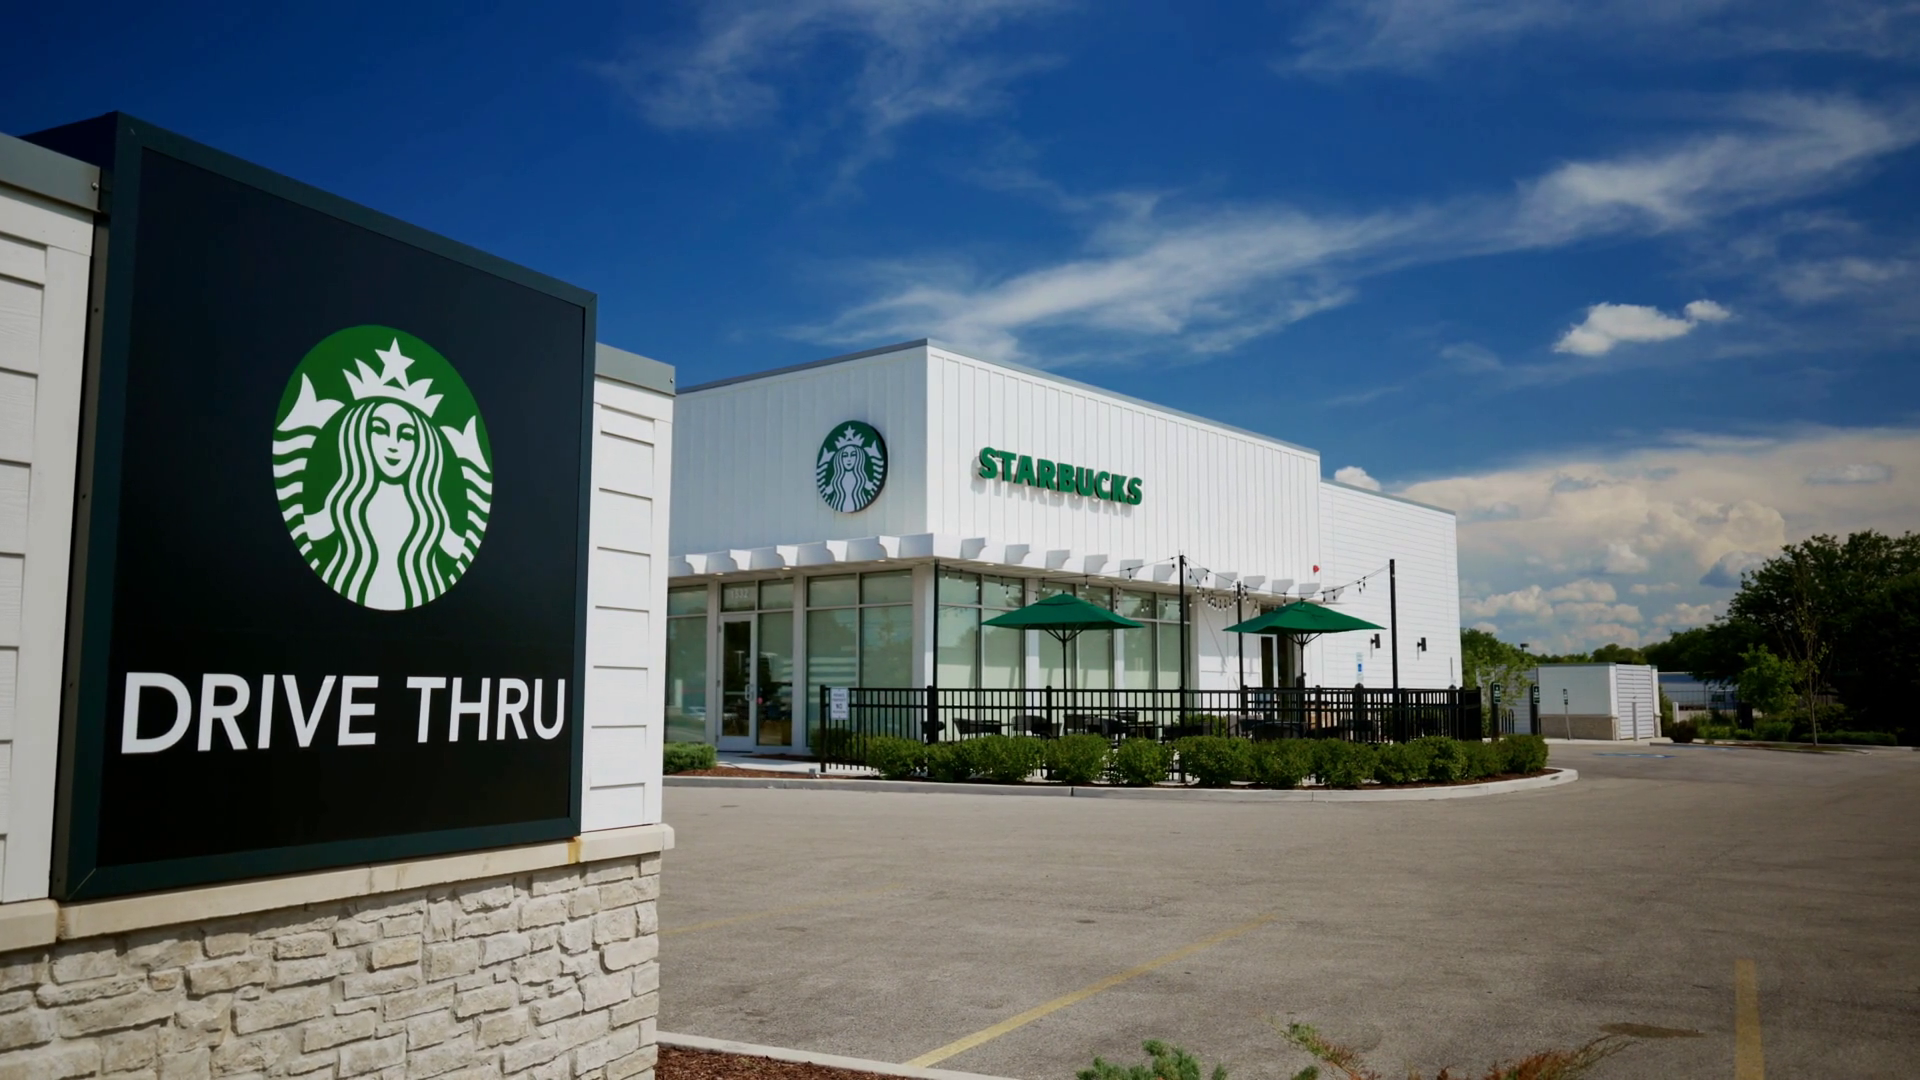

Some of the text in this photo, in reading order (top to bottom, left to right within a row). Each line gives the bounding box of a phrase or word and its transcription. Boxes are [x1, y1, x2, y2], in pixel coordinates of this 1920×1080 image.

[979, 447, 1143, 505] STARBUCKS
[121, 672, 566, 754] DRIVE THRU
